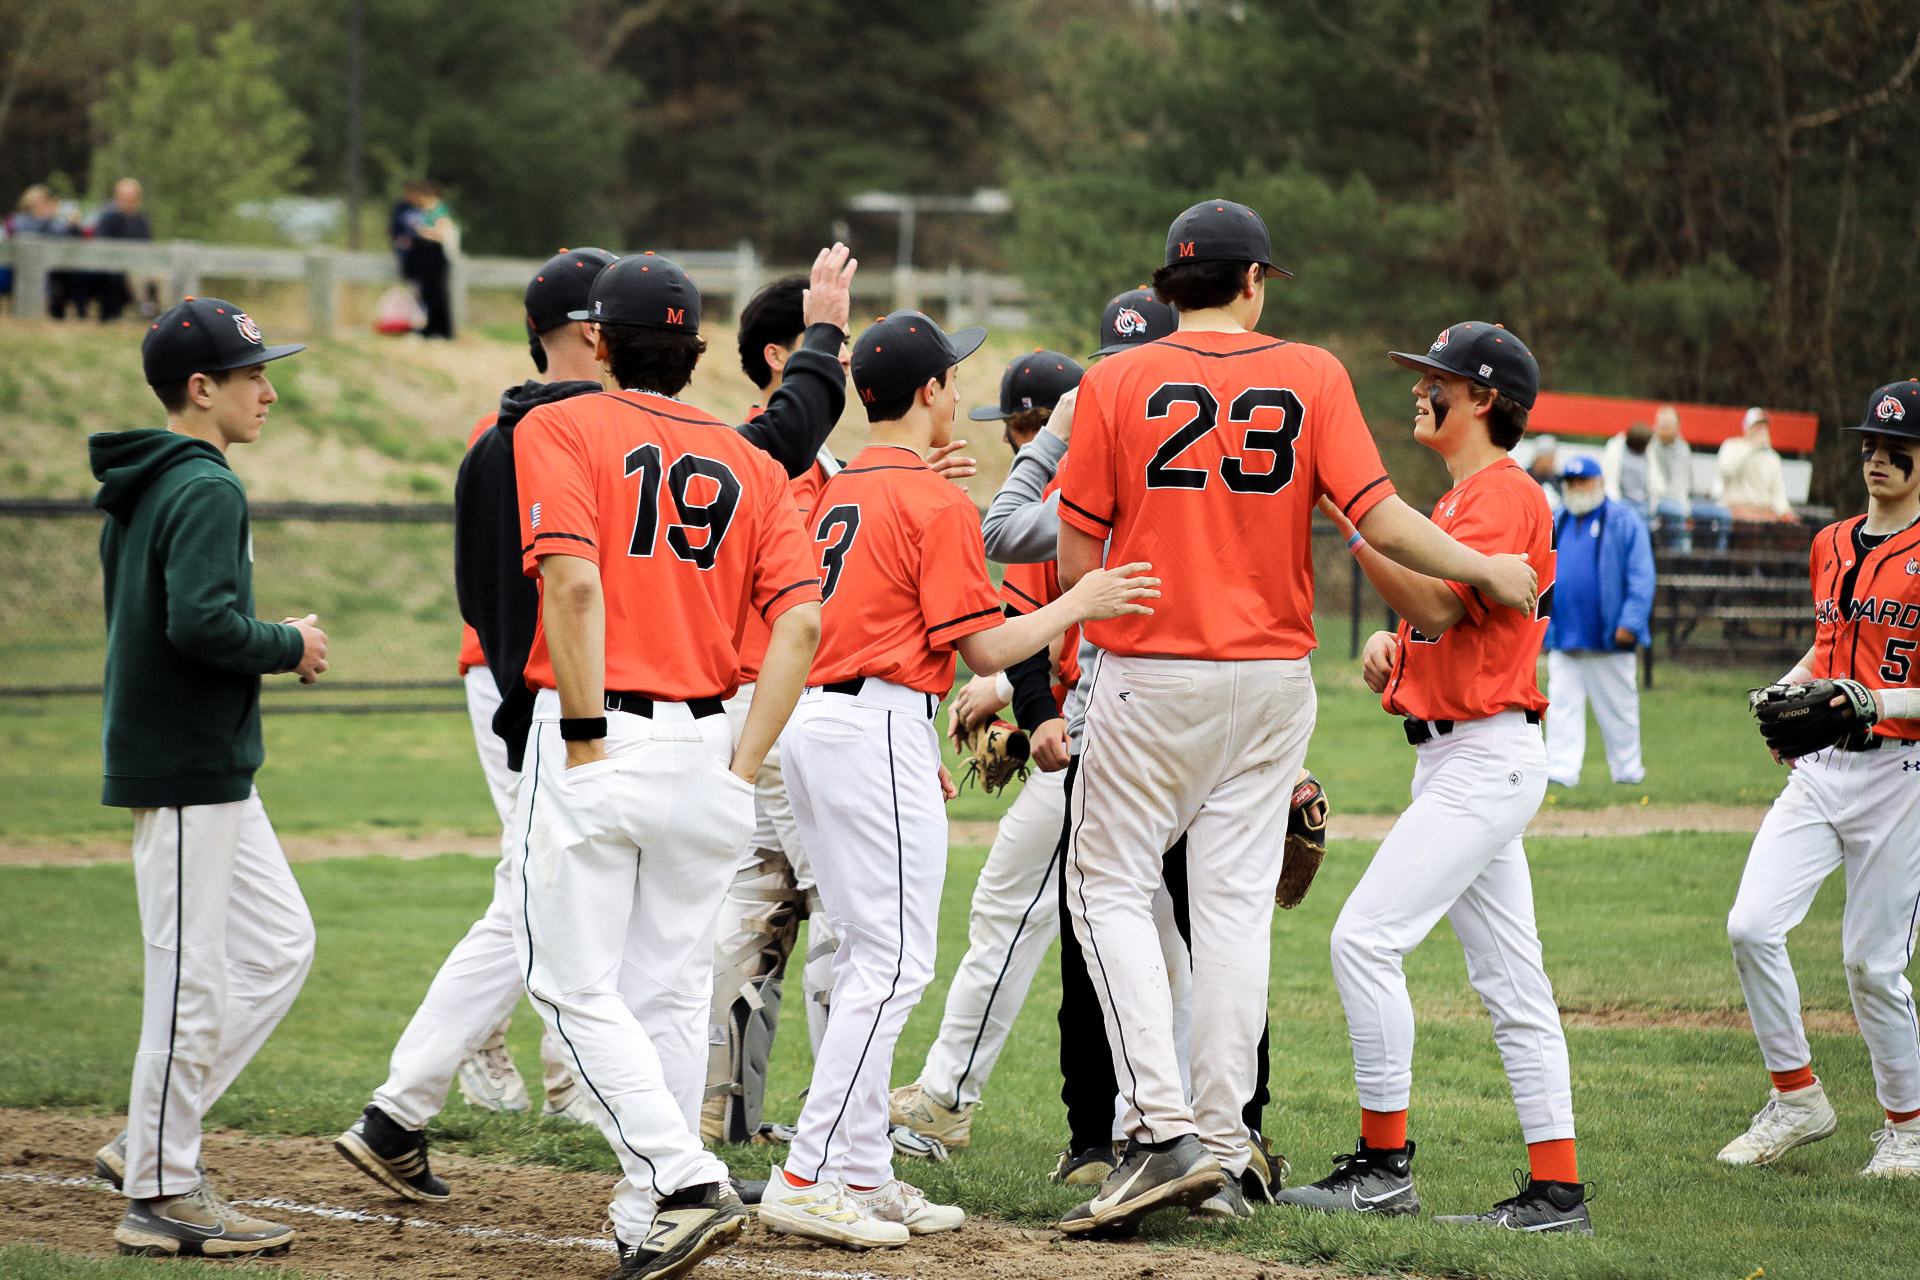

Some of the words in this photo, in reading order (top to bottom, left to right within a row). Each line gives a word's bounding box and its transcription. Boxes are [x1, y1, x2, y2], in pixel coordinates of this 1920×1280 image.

[1179, 242, 1196, 258] M
[666, 307, 685, 325] M
[859, 388, 877, 403] M
[1145, 382, 1306, 495] 23
[624, 442, 743, 571] 19
[814, 503, 861, 607] 3
[1878, 637, 1918, 684] 5
[1777, 707, 1810, 719] A2000
